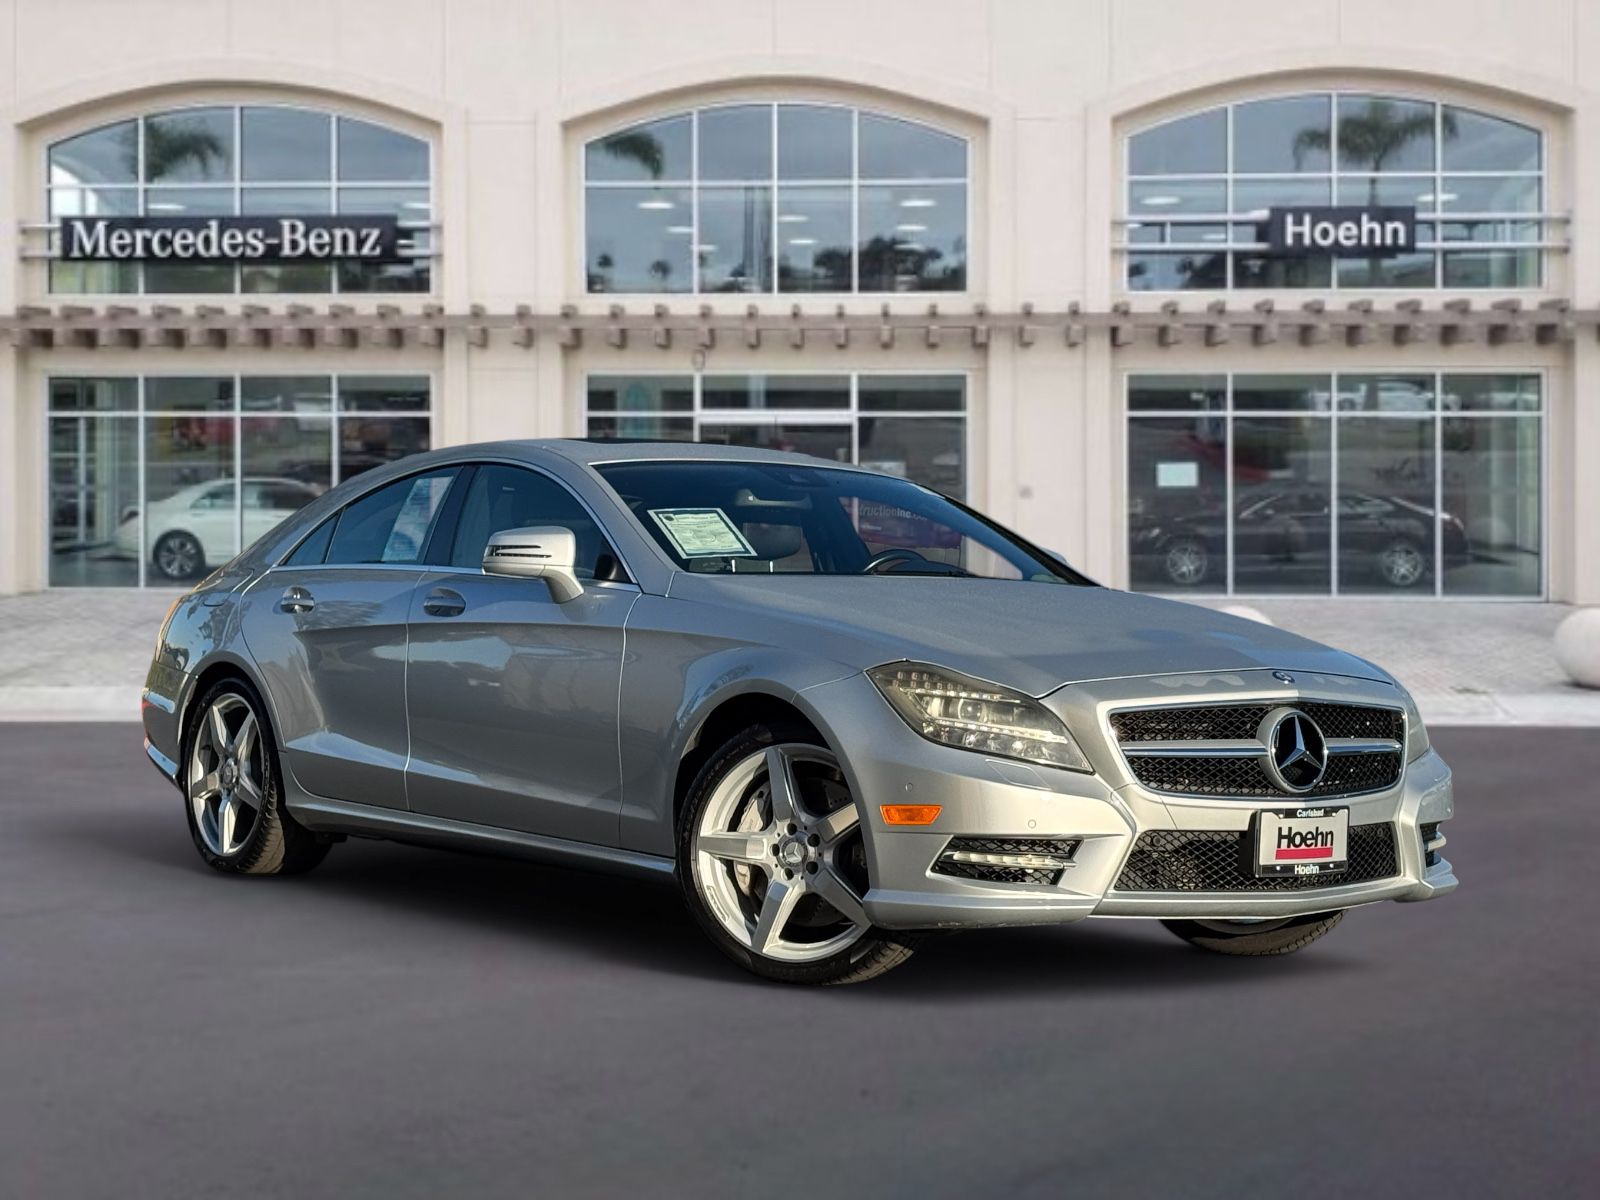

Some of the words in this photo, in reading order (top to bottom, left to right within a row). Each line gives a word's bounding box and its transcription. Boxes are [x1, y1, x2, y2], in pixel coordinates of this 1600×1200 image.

[69, 219, 382, 259] Mercedes-Benz
[1285, 212, 1406, 247] Hoehn
[1296, 809, 1324, 817] Carlsbad
[1277, 826, 1334, 849] Hoehn
[1294, 864, 1320, 875] Hoehn
